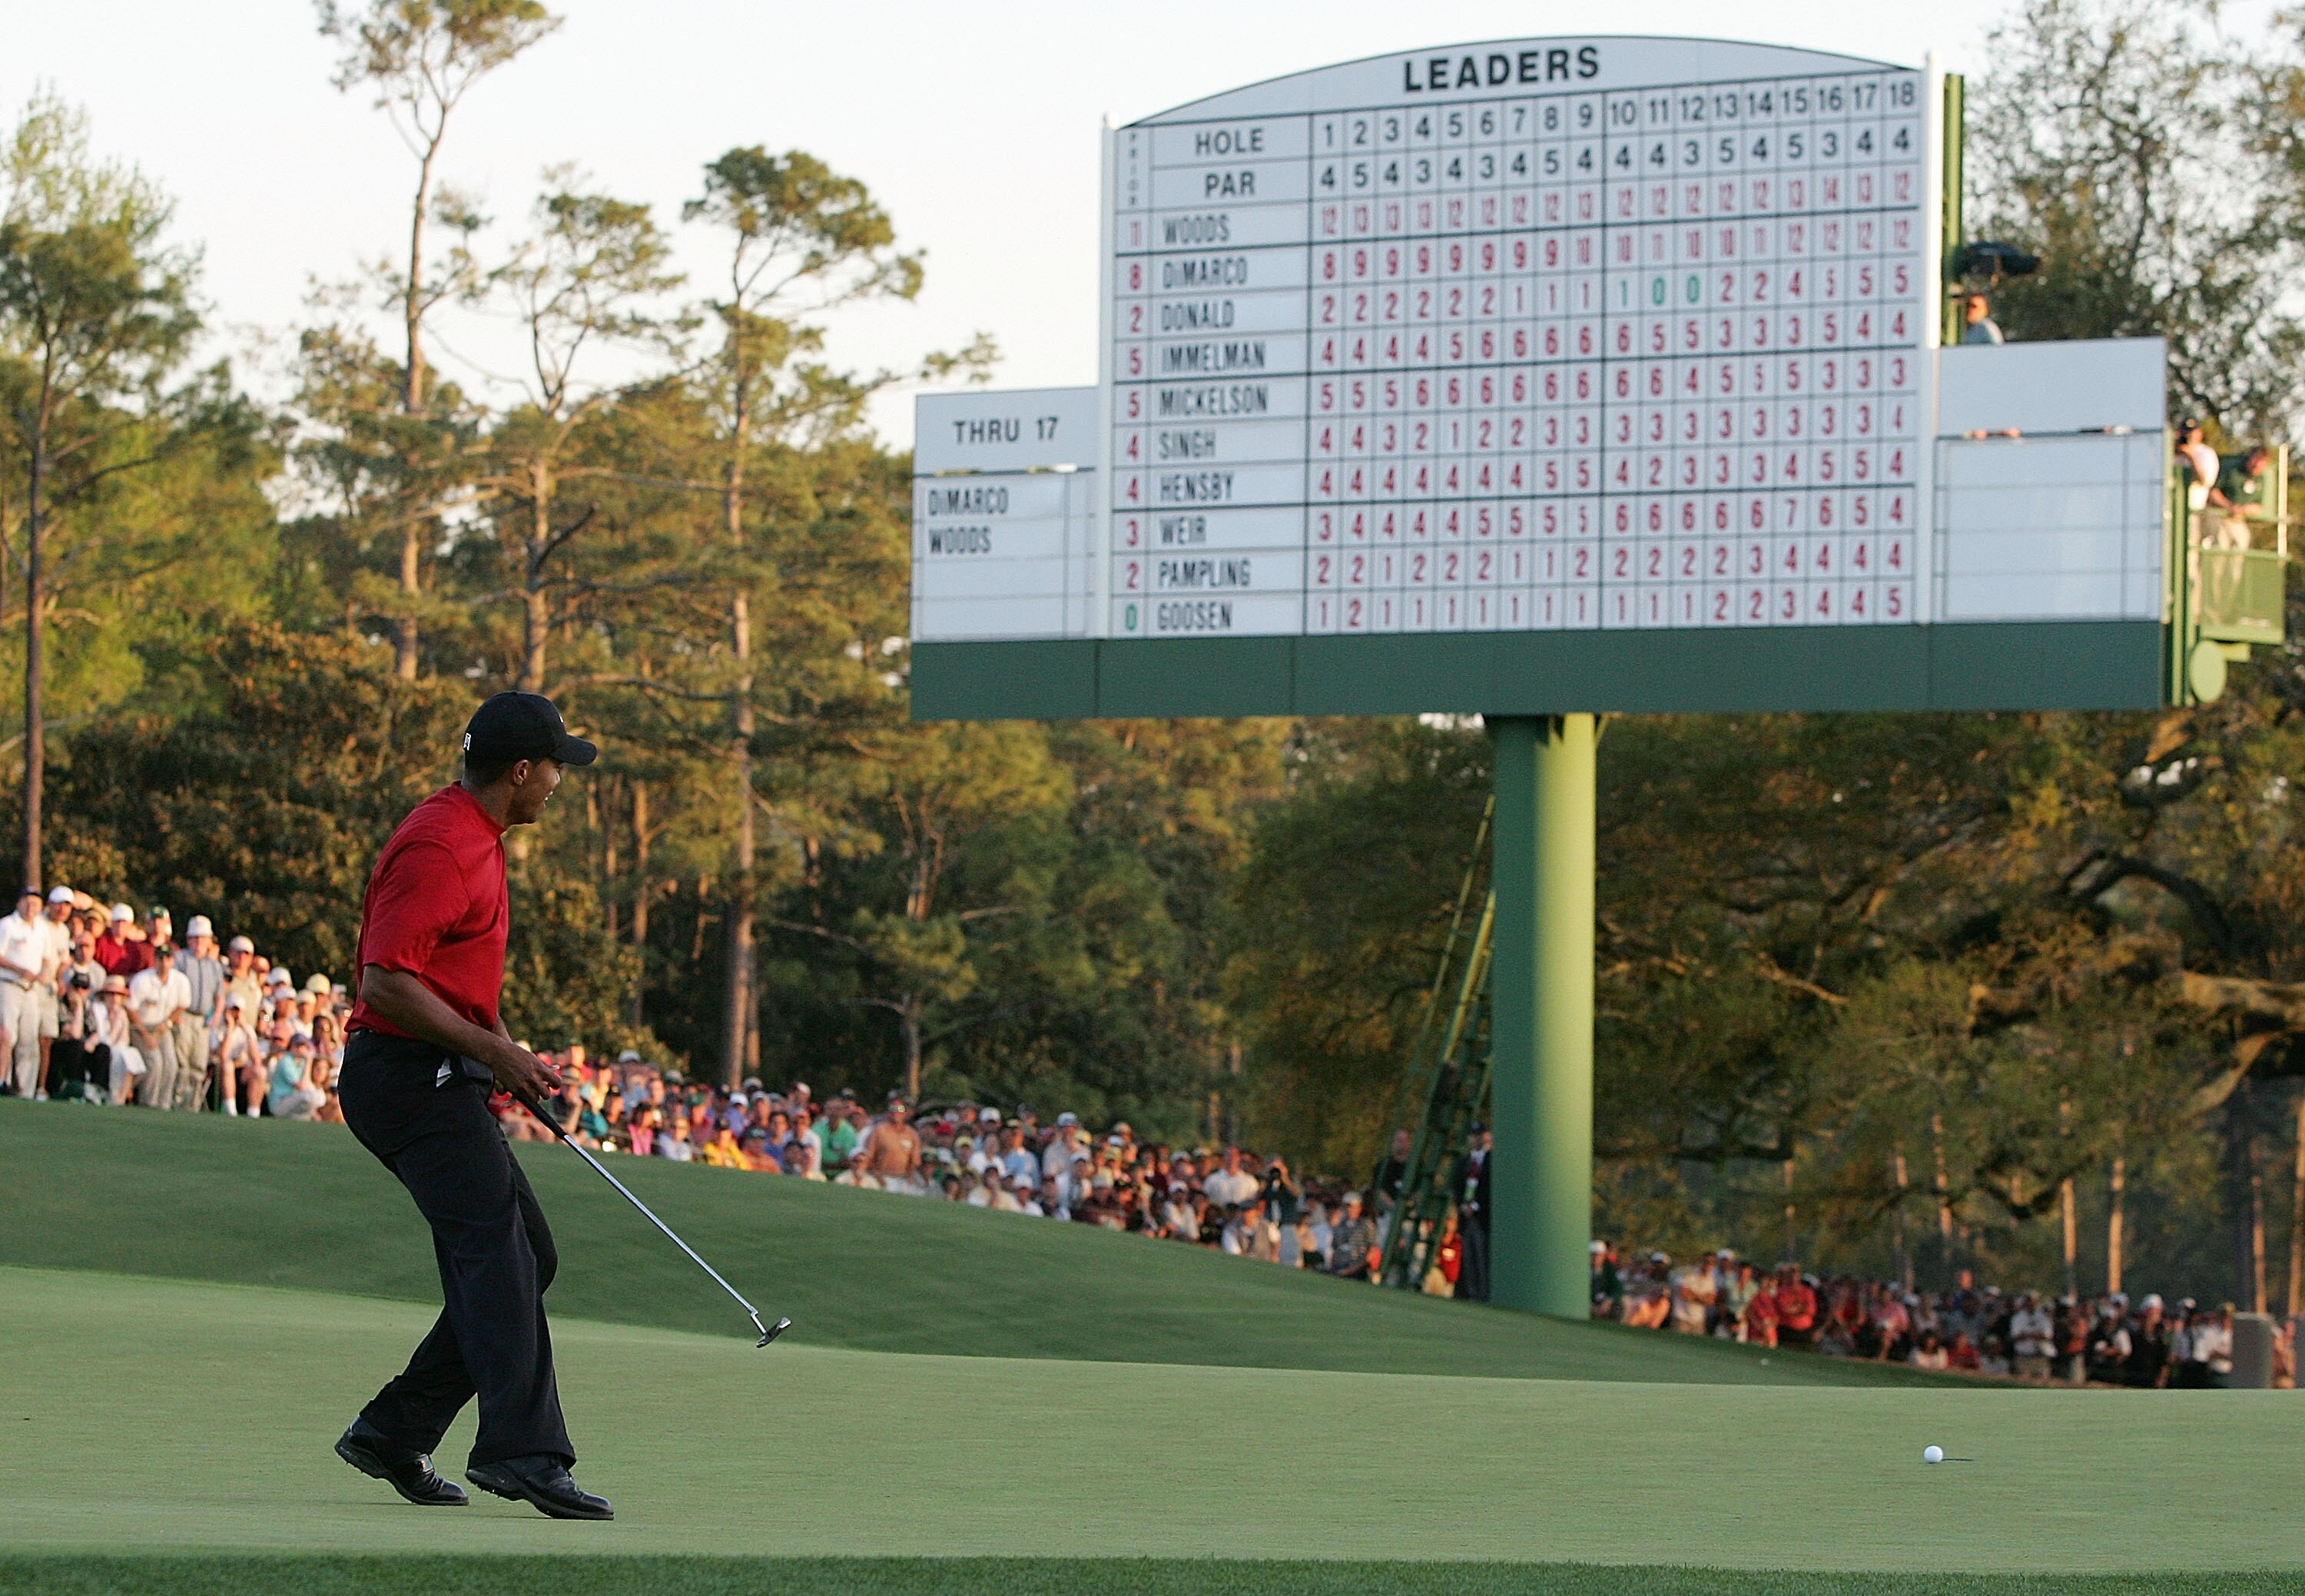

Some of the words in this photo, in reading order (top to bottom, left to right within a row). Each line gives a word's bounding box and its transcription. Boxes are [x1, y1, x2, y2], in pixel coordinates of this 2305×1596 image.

[1404, 47, 1600, 93] LEADERS
[1196, 128, 1264, 154] HOLE
[1325, 122, 1333, 147] 1
[1354, 120, 1368, 145] 2
[1385, 117, 1400, 143] 3
[1415, 115, 1431, 141] 4
[1448, 111, 1463, 138] 5
[1480, 110, 1494, 135] 6
[1514, 107, 1526, 132] 7
[1544, 105, 1559, 131] 8
[1578, 103, 1594, 128] 9
[1610, 100, 1637, 126] 10
[1649, 98, 1669, 123] 11
[1681, 95, 1705, 121] 12
[1714, 93, 1739, 118] 13
[1748, 91, 1773, 114] 14
[1783, 88, 1809, 114] 15
[1818, 86, 1842, 111] 16
[1853, 82, 1878, 109] 17
[1890, 81, 1915, 107] 18
[1205, 171, 1255, 197] PAR
[1320, 165, 1335, 191] 4
[1354, 162, 1368, 188] 5
[1385, 161, 1399, 186] 4
[1416, 158, 1431, 184] 3
[1448, 157, 1462, 182] 4
[1480, 154, 1495, 180] 3
[1512, 152, 1527, 178] 4
[1544, 149, 1560, 175] 5
[1577, 148, 1592, 173] 4
[1615, 144, 1630, 171] 4
[1650, 142, 1666, 168] 4
[1684, 140, 1700, 166] 3
[1720, 137, 1735, 164] 5
[1752, 136, 1768, 162] 4
[1787, 133, 1804, 160] 5
[1822, 131, 1838, 158] 3
[1856, 129, 1873, 155] 4
[1893, 127, 1910, 153] 4
[1162, 214, 1229, 244] WOODS
[1131, 264, 1142, 290] 8
[1324, 252, 1335, 280] 8
[1355, 249, 1366, 277] 9
[1388, 247, 1399, 277] 9
[1418, 246, 1430, 274] 9
[1451, 244, 1461, 272] 9
[1483, 243, 1494, 270] 9
[1515, 240, 1526, 270] 9
[1546, 239, 1557, 267] 9
[1131, 306, 1143, 333] 2
[1161, 300, 1234, 330] DONALD
[1323, 295, 1335, 324] 2
[1355, 294, 1368, 323] 2
[1386, 292, 1398, 321] 2
[1418, 290, 1430, 319] 2
[1450, 287, 1461, 318] 2
[1481, 287, 1495, 316] 2
[1514, 285, 1524, 314] 1
[1547, 282, 1557, 309] 1
[1581, 280, 1591, 309] 1
[1620, 278, 1630, 307] 1
[1652, 276, 1667, 306] 0
[1686, 274, 1700, 304] 0
[1721, 273, 1733, 303] 2
[1755, 270, 1767, 301] 2
[1789, 270, 1802, 298] 4
[1859, 266, 1872, 296] 5
[1895, 264, 1907, 295] 5
[1130, 347, 1143, 376] 5
[1161, 343, 1266, 372] IMMELMAN
[1323, 339, 1334, 366] 4
[1354, 337, 1365, 363] 4
[1387, 336, 1398, 362] 4
[1417, 334, 1428, 361] 4
[1451, 332, 1463, 361] 5
[1481, 330, 1494, 359] 6
[1514, 330, 1526, 357] 6
[1546, 327, 1558, 355] 6
[1579, 326, 1590, 355] 6
[1617, 324, 1630, 353] 6
[1652, 324, 1666, 353] 5
[1686, 320, 1698, 350] 5
[1720, 318, 1732, 347] 3
[1754, 317, 1767, 347] 3
[1789, 315, 1801, 346] 3
[1824, 313, 1836, 343] 5
[1858, 314, 1870, 340] 4
[1893, 311, 1905, 339] 4
[1129, 392, 1141, 418] 5
[1159, 387, 1268, 415] MICKELSON
[953, 418, 1021, 443] THRU
[1035, 417, 1060, 440] 17
[1128, 435, 1139, 461] 4
[1159, 430, 1216, 459] SINGH
[1128, 476, 1139, 503] 4
[1159, 473, 1234, 502] HENSBY
[928, 527, 992, 554] WOODS
[1128, 519, 1139, 547] 3
[1159, 516, 1206, 544] WEIR
[1320, 513, 1332, 541] 3
[1352, 513, 1364, 539] 4
[1383, 511, 1395, 538] 4
[1414, 510, 1426, 538] 4
[1448, 509, 1460, 536] 4
[1479, 507, 1491, 536] 5
[1511, 506, 1523, 536] 5
[1544, 506, 1557, 535] 5
[1615, 503, 1627, 533] 6
[1649, 503, 1661, 532] 6
[1683, 503, 1695, 530] 6
[1716, 501, 1728, 530] 6
[1750, 499, 1763, 529] 6
[1786, 496, 1798, 527] 7
[1819, 497, 1832, 526] 6
[1855, 495, 1868, 526] 5
[1891, 496, 1902, 524] 4
[1126, 562, 1139, 589] 2
[1158, 559, 1251, 588] PAMPLING
[1125, 602, 1139, 632] 0
[1157, 602, 1232, 630] GOOSEN
[1319, 601, 1329, 627] 1
[1349, 599, 1361, 628] 2
[1383, 599, 1391, 627] 1
[1415, 596, 1424, 625] 1
[1448, 596, 1458, 624] 1
[1478, 595, 1488, 622] 1
[1510, 595, 1521, 624] 1
[1544, 593, 1554, 622] 1
[1577, 592, 1586, 621] 1
[1617, 592, 1627, 621] 1
[1650, 593, 1660, 621] 1
[1684, 591, 1693, 619] 1
[1715, 591, 1727, 622] 2
[1750, 590, 1763, 619] 2
[1784, 589, 1796, 619] 3
[1818, 589, 1829, 617] 4
[1852, 589, 1865, 617] 4
[1889, 587, 1901, 618] 5
